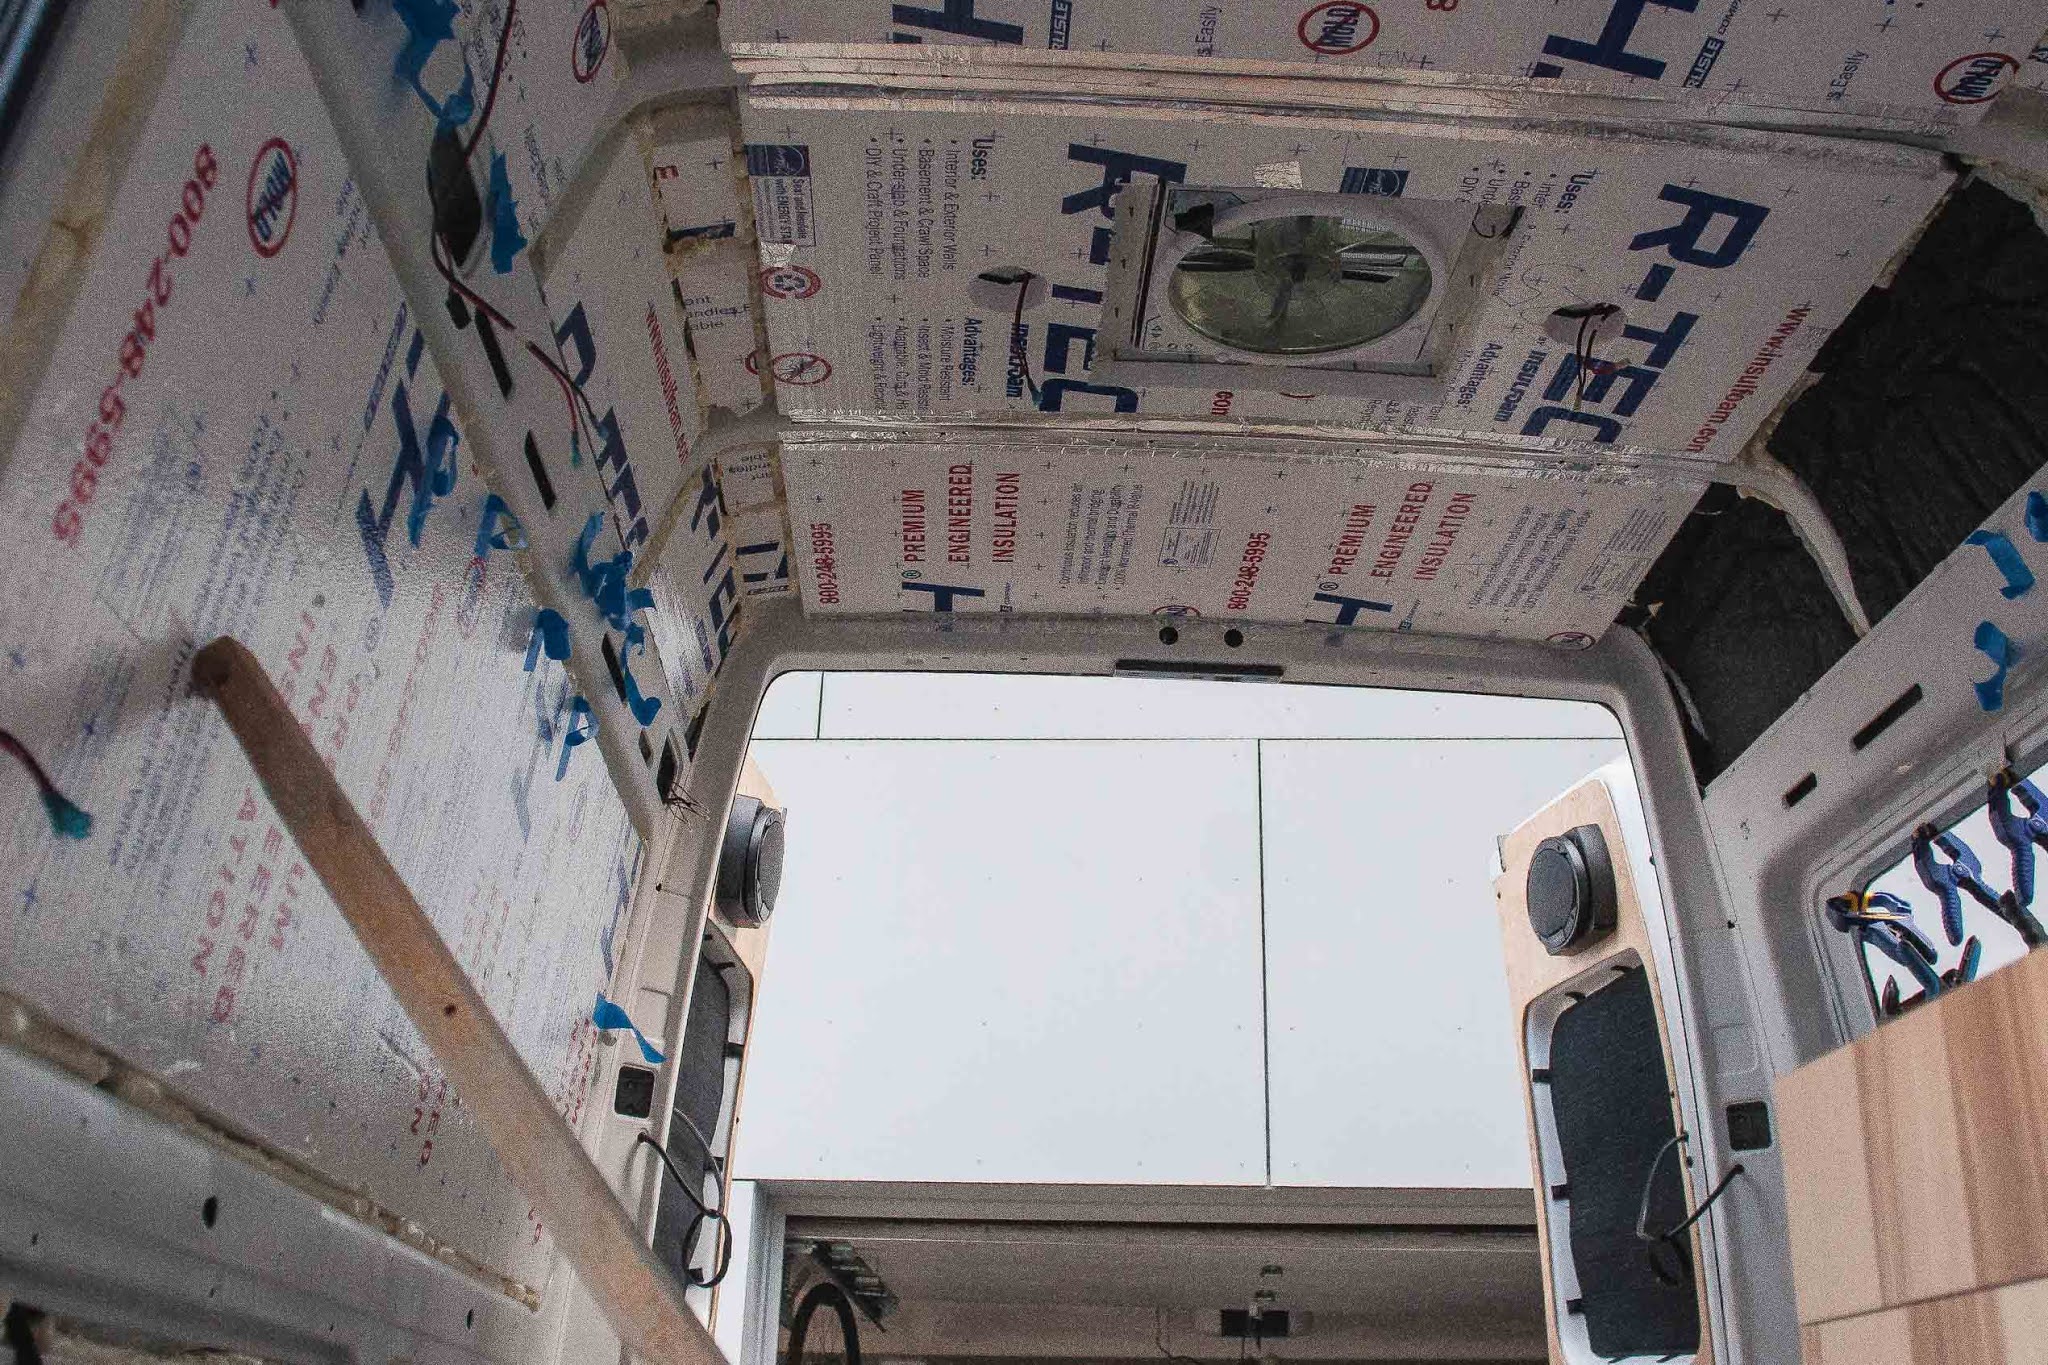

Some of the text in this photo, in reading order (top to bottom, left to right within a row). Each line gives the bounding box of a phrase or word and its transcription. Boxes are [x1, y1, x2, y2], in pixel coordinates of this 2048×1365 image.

[971, 138, 994, 180] Uses:
[1463, 177, 1479, 200] DIY
[1555, 173, 1595, 213] Uses:
[778, 196, 790, 223] ENERGY
[865, 148, 884, 275] DIY & Craft Project Panel
[891, 148, 908, 280] Under-slab & Foundations
[915, 149, 935, 278] Basement & Crawl Space
[942, 149, 960, 271] Interior & Exterior Walls
[52, 143, 218, 547] 800-248-5995
[869, 325, 885, 371] Lightweight
[918, 325, 930, 352] Insect
[918, 362, 930, 382] Mold
[938, 325, 954, 401] Moisture Resistant
[959, 318, 982, 386] Advantages:
[1456, 343, 1503, 412] Advantages:
[948, 463, 973, 563] ENGINEERED
[992, 472, 1019, 563] INSULATION
[1069, 494, 1081, 519] reduces
[1072, 483, 1082, 492] air
[902, 489, 925, 562] PREMIUM
[1328, 503, 1377, 576] PREMIUM
[1371, 481, 1434, 578] ENGINEERED
[1413, 492, 1478, 581] INSULATION
[811, 522, 839, 605] 800-248-5995
[1227, 532, 1271, 611] 800-248-5995
